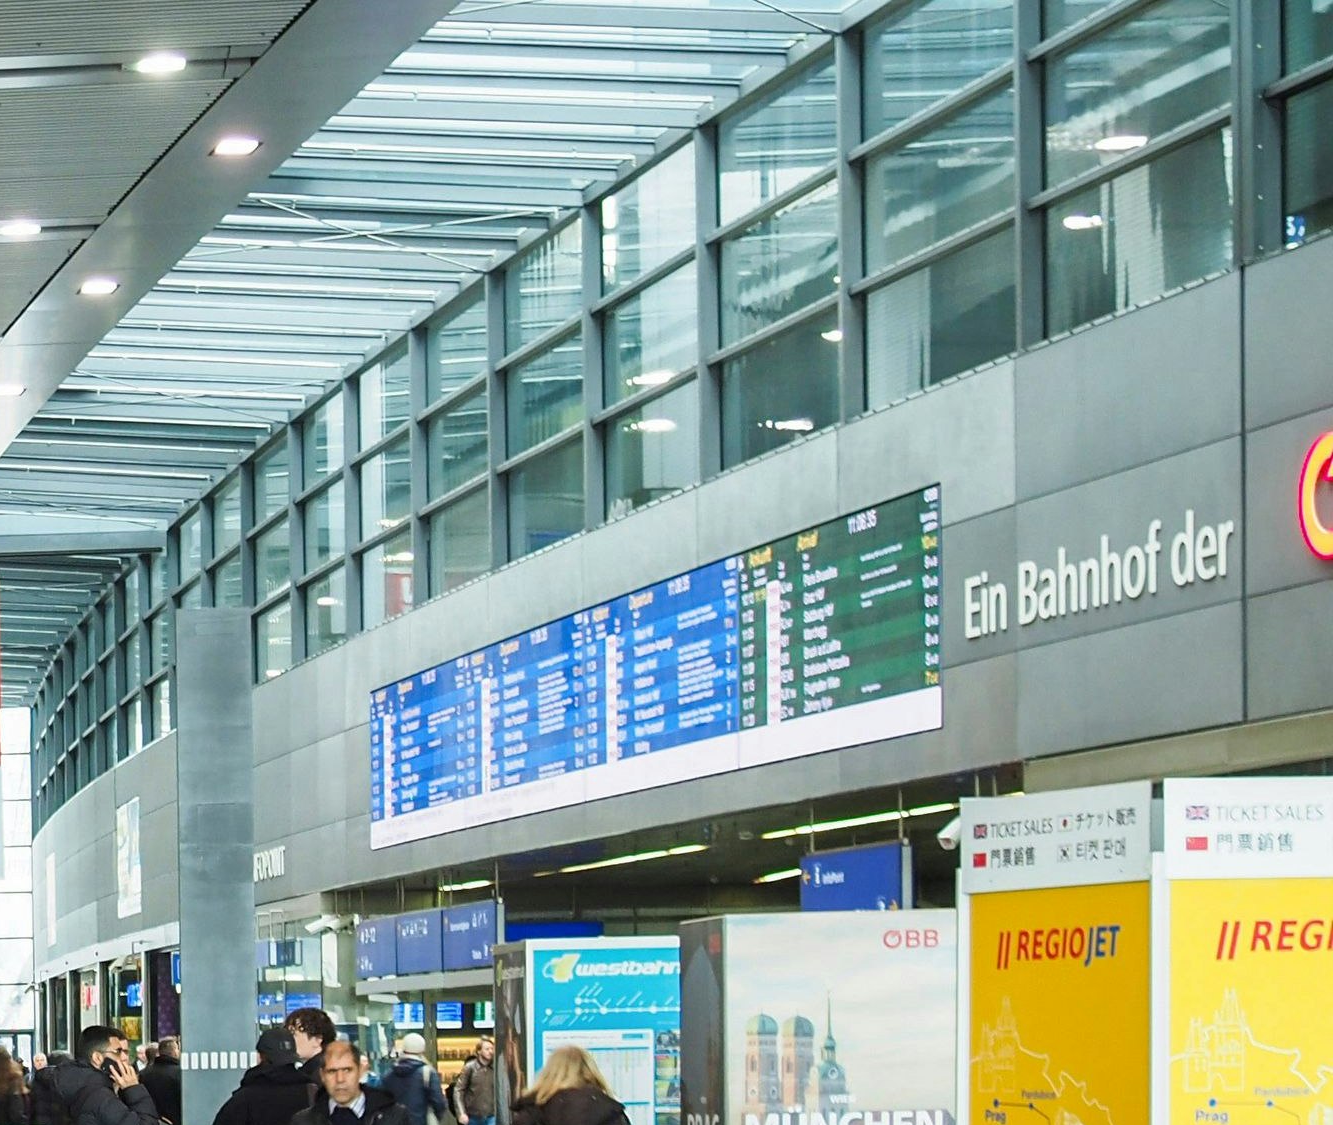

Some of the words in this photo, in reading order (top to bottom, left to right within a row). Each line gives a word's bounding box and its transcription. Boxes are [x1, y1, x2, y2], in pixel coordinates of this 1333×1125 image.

[964, 570, 1008, 640] Ein
[1017, 519, 1162, 627] Bahnhof
[1171, 509, 1234, 588] der
[1217, 805, 1270, 821] TICKET
[1275, 804, 1325, 821] SALES
[990, 820, 1022, 838] TICKET
[1023, 818, 1053, 836] SALES
[1017, 925, 1121, 967] REGIOJET
[576, 960, 680, 977] westbahn
[985, 1110, 1006, 1124] Prag
[1195, 1110, 1229, 1125] Prag
